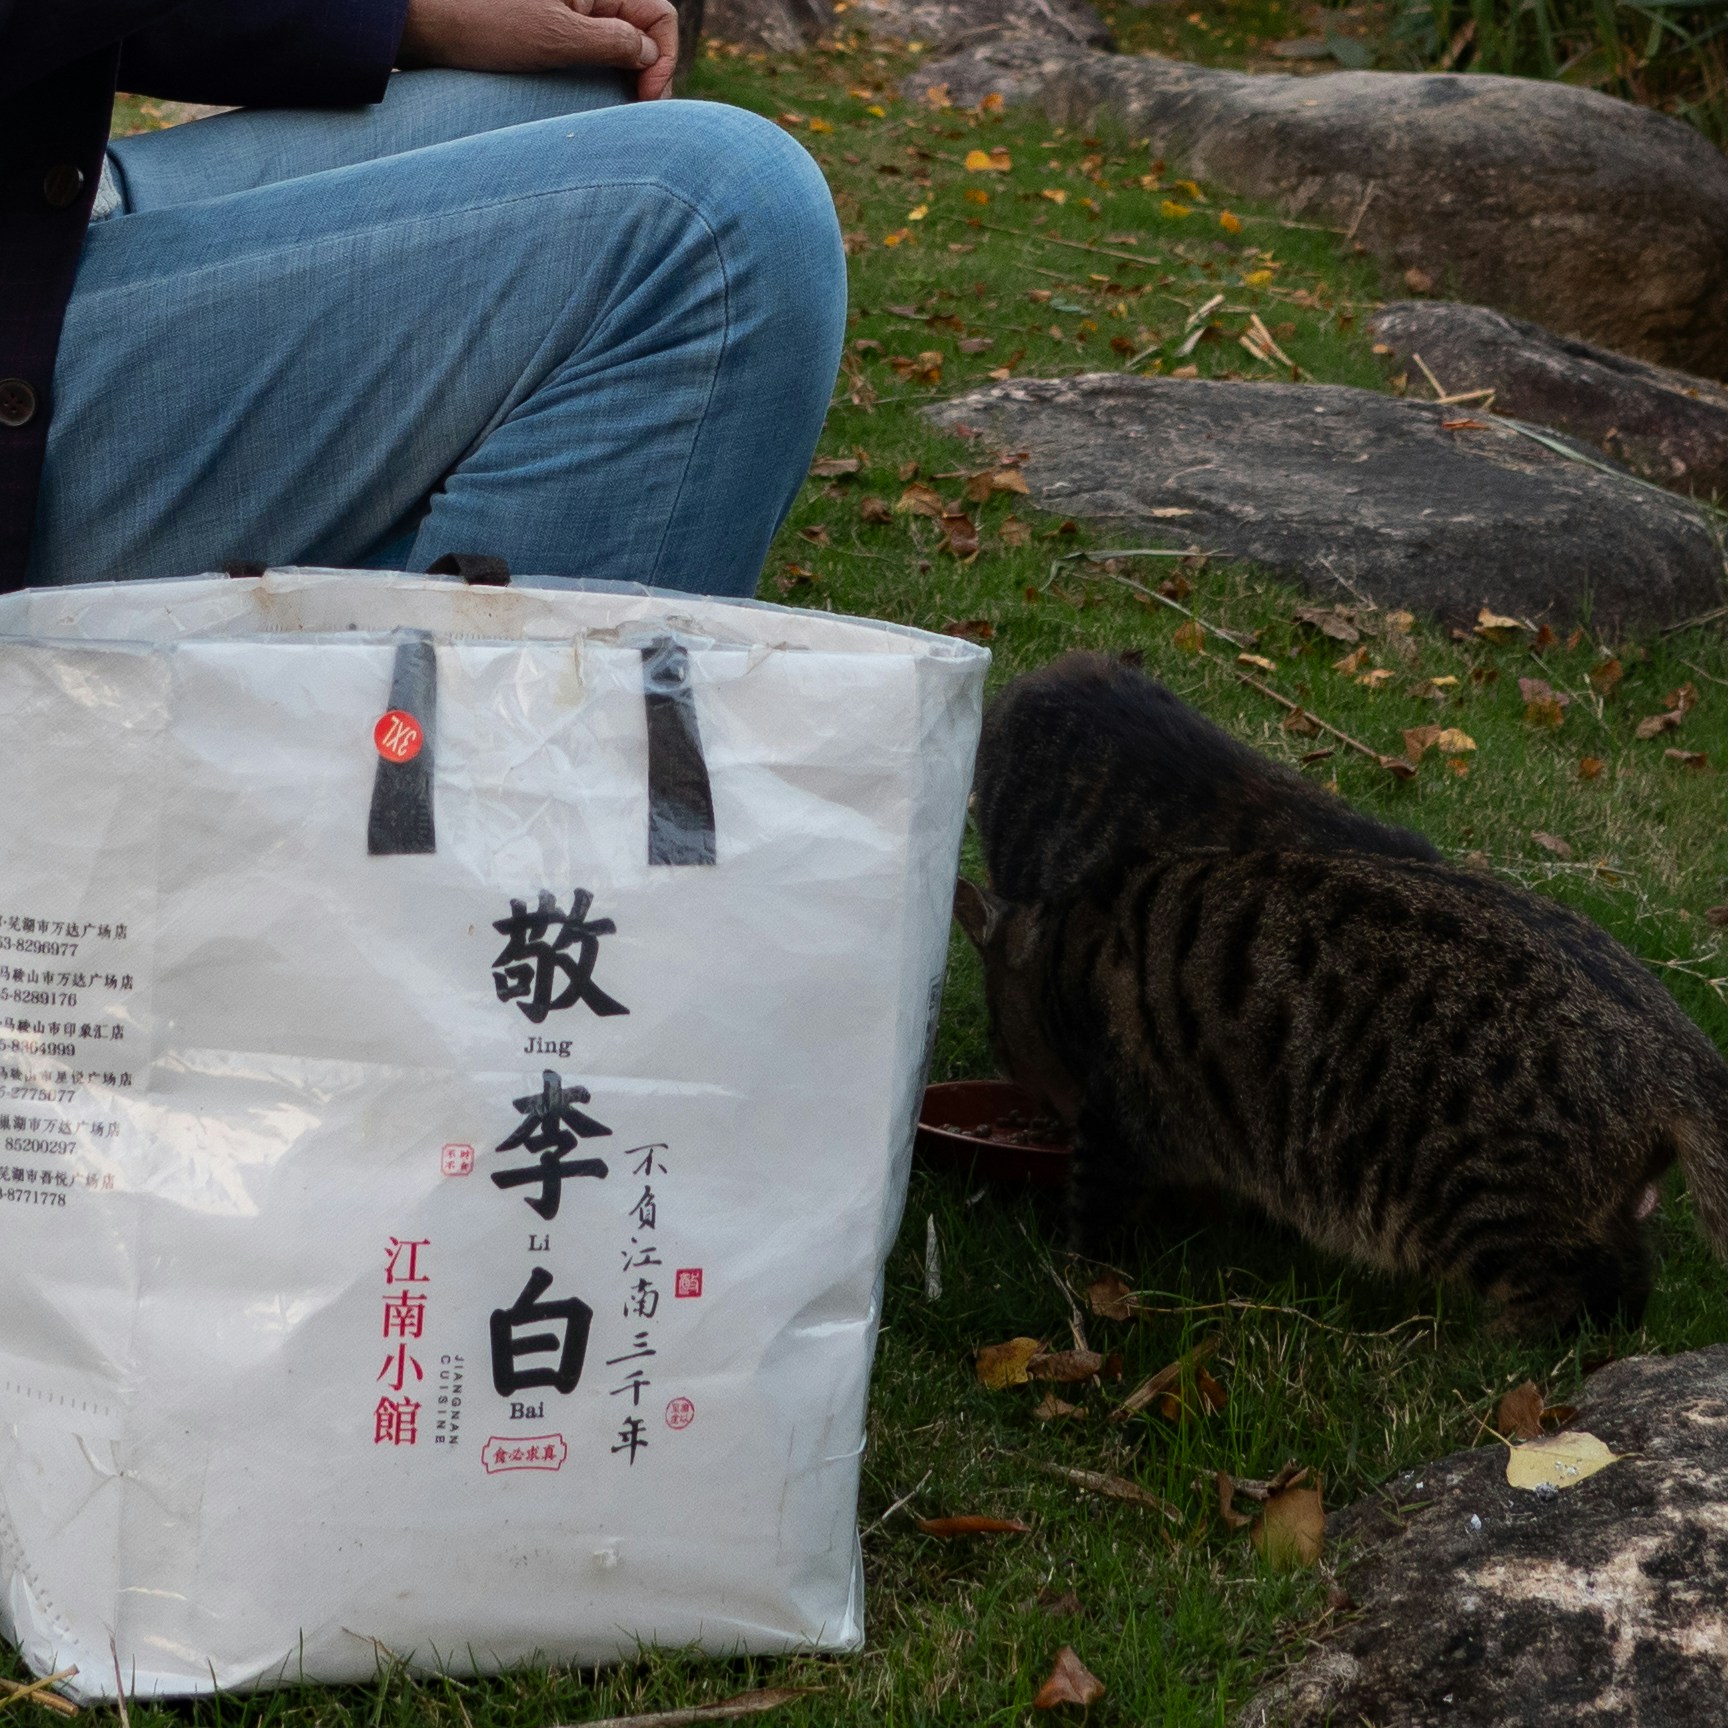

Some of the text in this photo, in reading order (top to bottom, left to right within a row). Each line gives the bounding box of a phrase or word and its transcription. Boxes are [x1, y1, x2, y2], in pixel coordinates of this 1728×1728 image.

[382, 715, 418, 757] 3XL
[523, 1036, 574, 1058] Jing
[527, 1234, 551, 1252] Li
[374, 1235, 431, 1446] 江南小館
[434, 1354, 451, 1444] CUISINE
[448, 1354, 465, 1445] JIANGNAN
[509, 1402, 545, 1420] Bai
